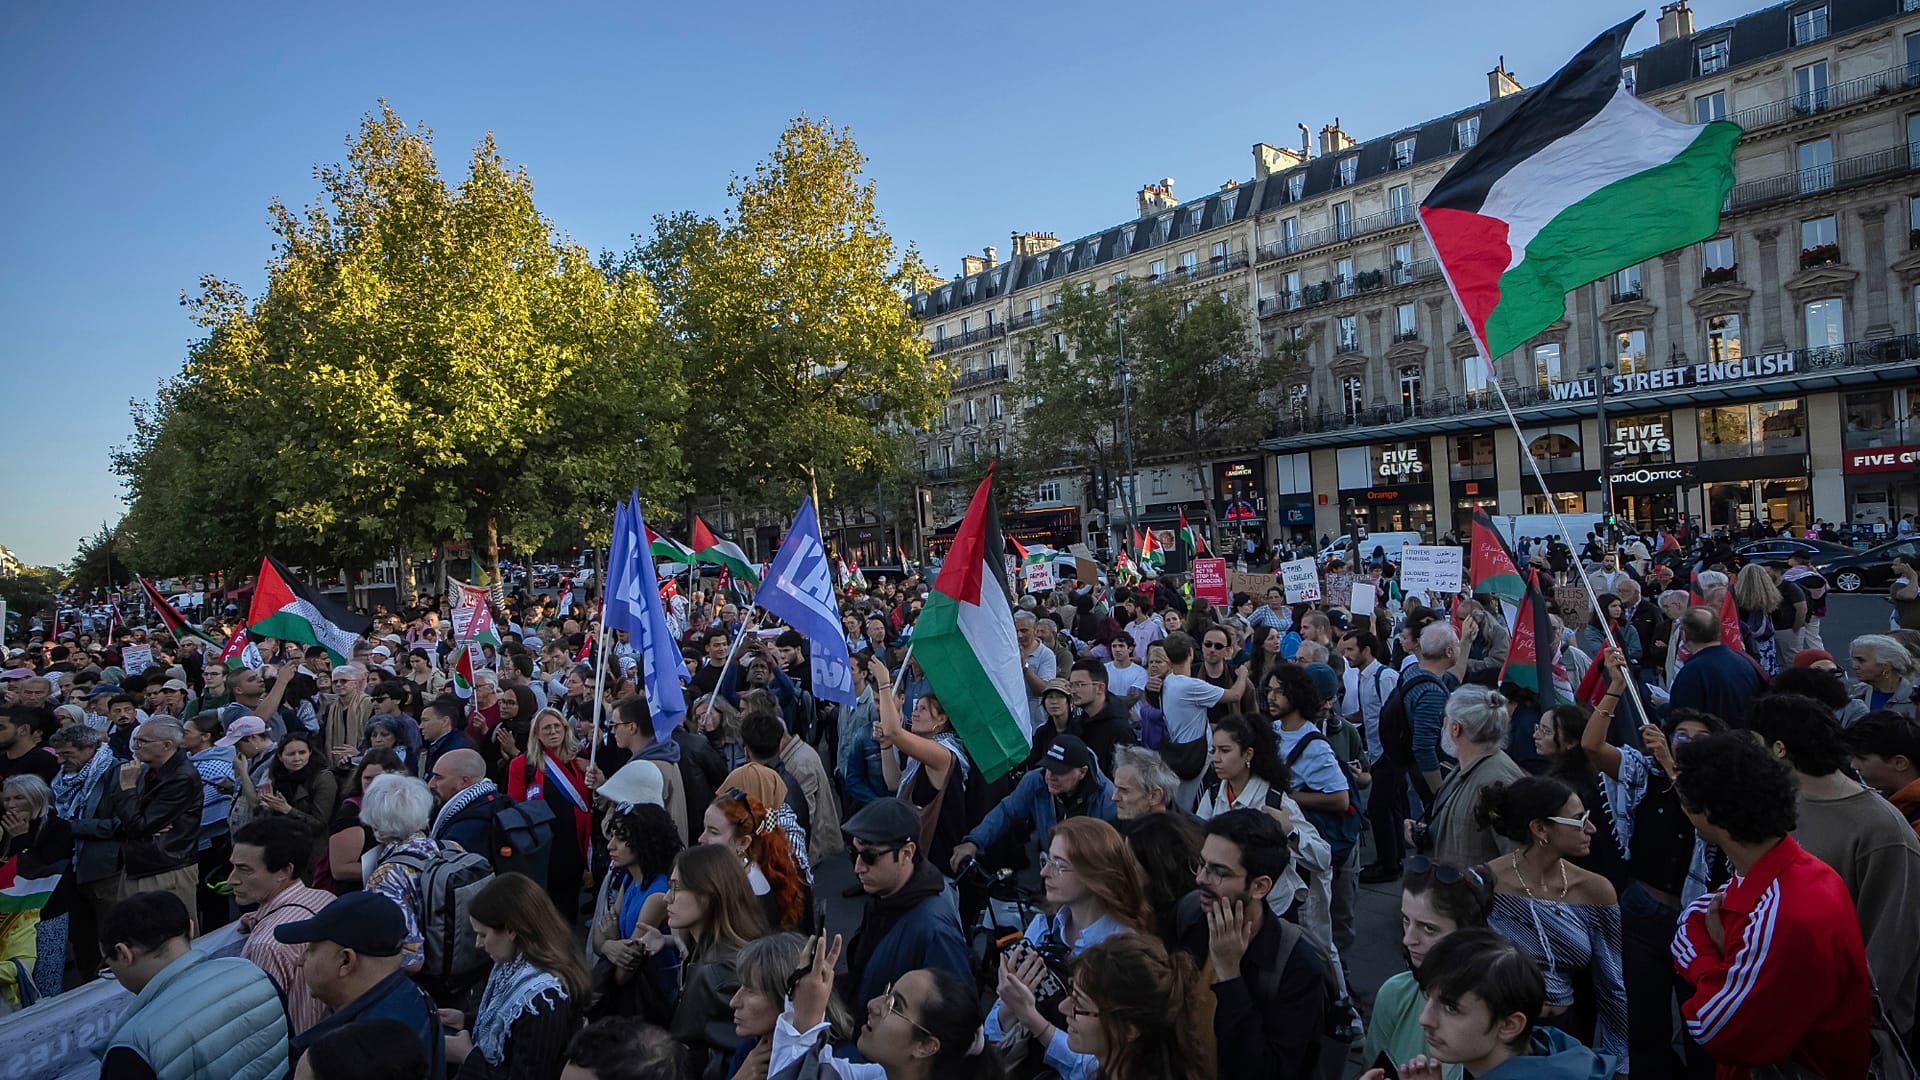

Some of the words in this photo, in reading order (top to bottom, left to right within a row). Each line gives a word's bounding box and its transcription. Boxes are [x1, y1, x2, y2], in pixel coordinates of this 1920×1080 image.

[1613, 367, 1689, 393] STREET
[1695, 352, 1794, 383] ENGLISH
[1616, 424, 1664, 441] FIVE
[1383, 449, 1418, 463] FIVE
[1854, 454, 1895, 467] FIVE
[1379, 461, 1423, 476] GUYS
[1367, 491, 1398, 499] Orange
[1239, 574, 1271, 585] STOP
[1300, 589, 1319, 600] GAZA
[1557, 589, 1583, 599] PLUS
